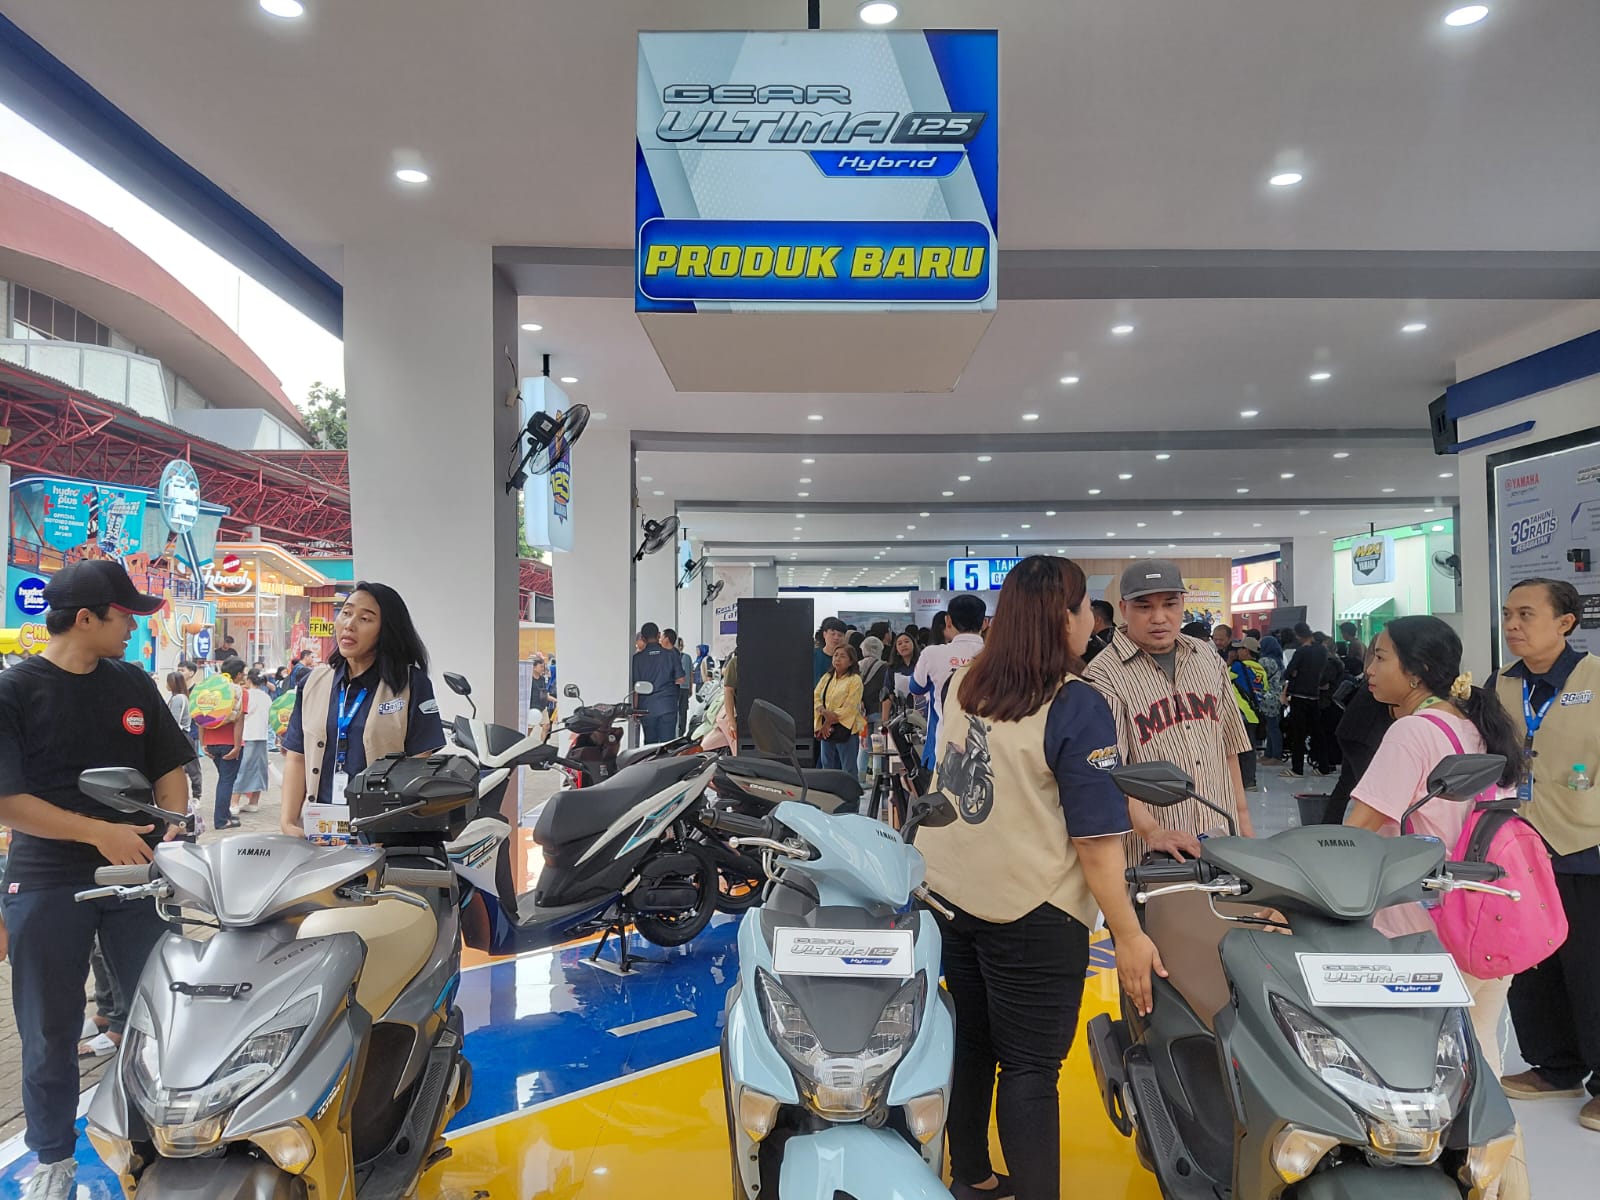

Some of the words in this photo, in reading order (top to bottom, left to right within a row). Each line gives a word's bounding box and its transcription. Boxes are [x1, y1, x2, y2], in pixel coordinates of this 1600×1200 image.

[663, 84, 851, 104] GEAR
[655, 111, 899, 144] ULTIMA
[907, 117, 970, 136] 125
[838, 155, 938, 172] Hybrid
[645, 245, 843, 279] PRODUK
[850, 246, 986, 279] BARU
[1513, 474, 1540, 488] YAMAHA
[52, 485, 81, 497] hydro
[57, 495, 78, 505] plus
[965, 564, 979, 590] 5
[876, 829, 897, 842] YAMAHA
[1317, 840, 1356, 848] YAMAHA
[237, 849, 271, 857] YAMAHA
[793, 937, 855, 946] GEAR
[274, 938, 326, 965] GEAR
[790, 944, 871, 957] ULTIMA
[1322, 964, 1392, 972] GEAR
[1323, 972, 1411, 983] ULTIMA
[1415, 973, 1440, 982] 125
